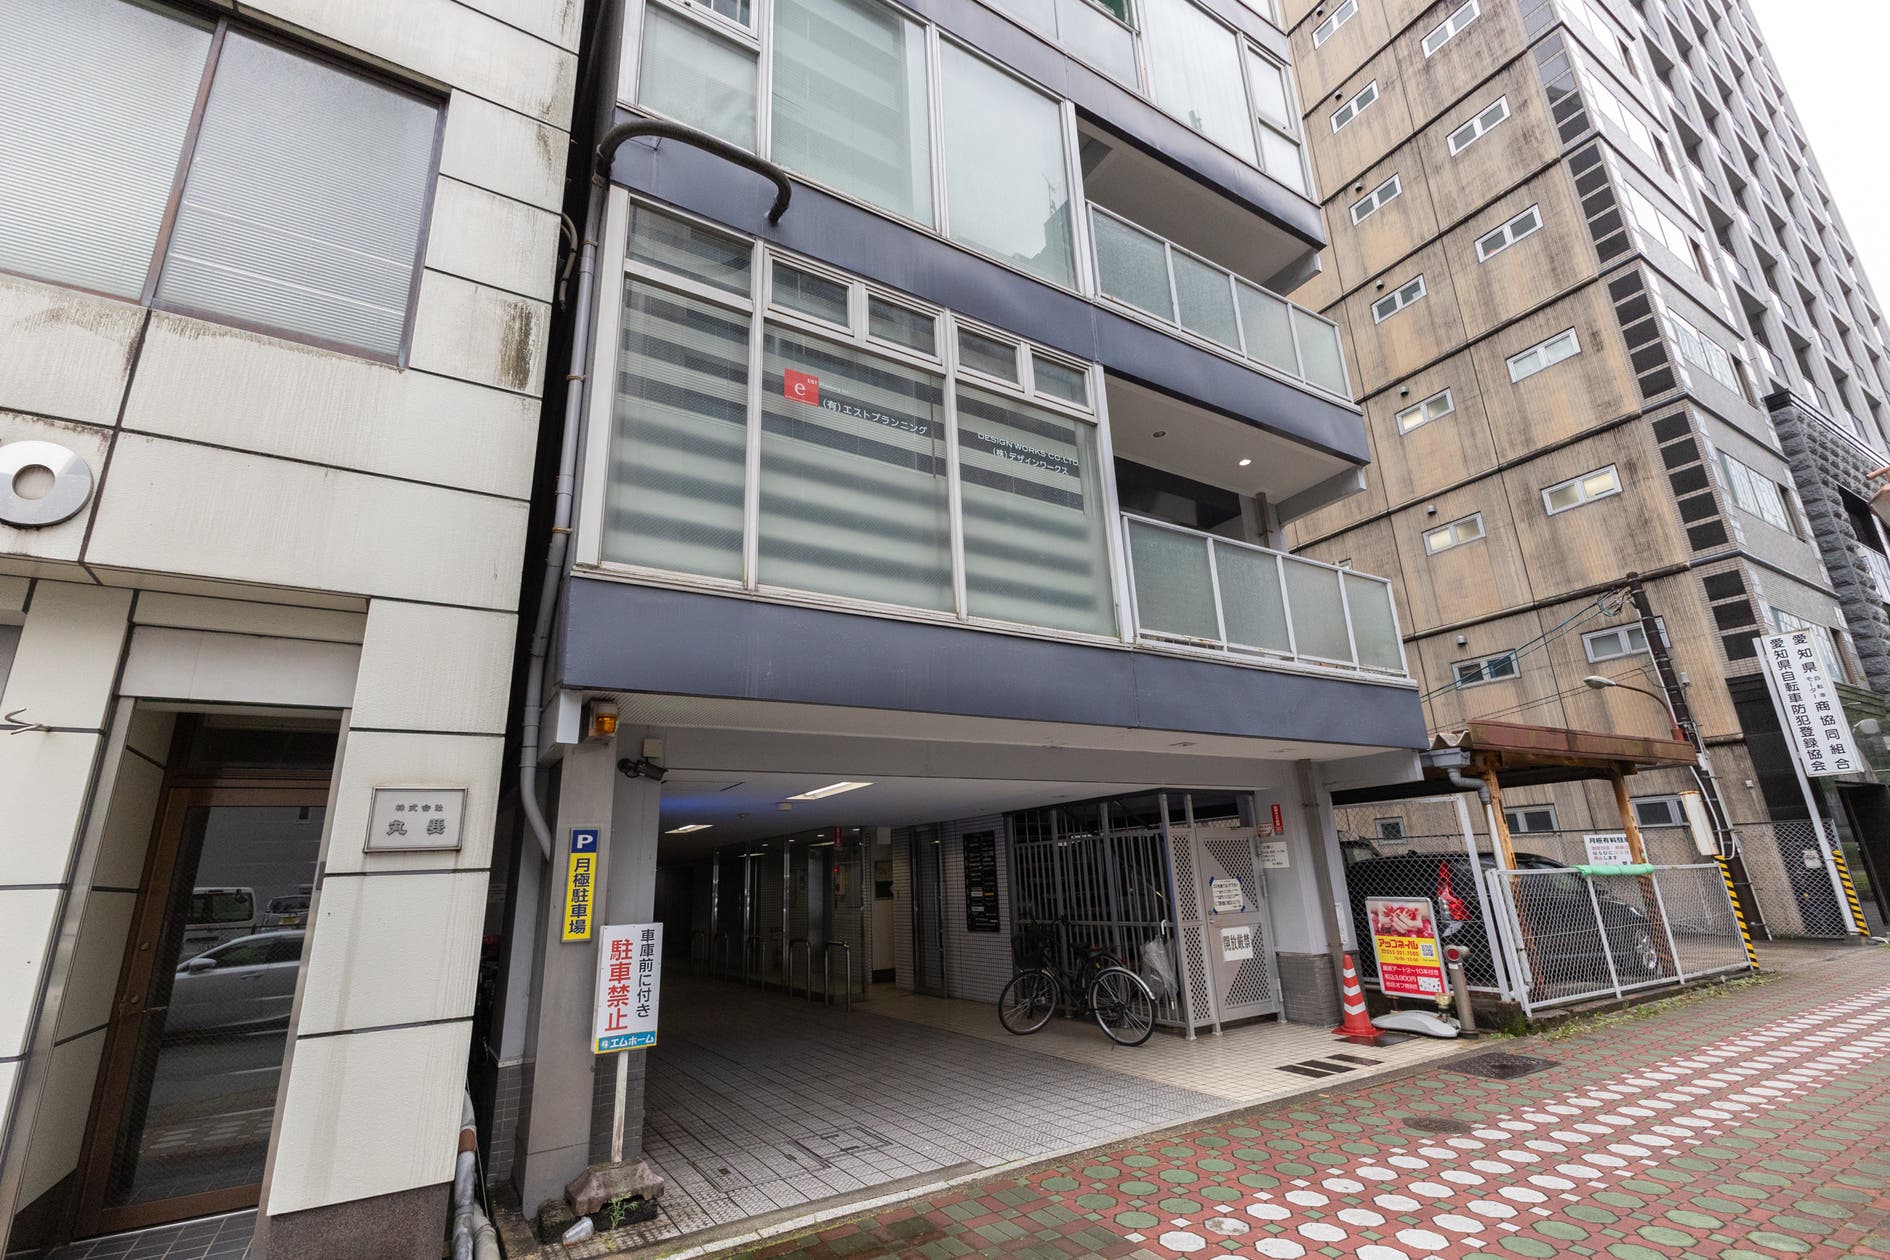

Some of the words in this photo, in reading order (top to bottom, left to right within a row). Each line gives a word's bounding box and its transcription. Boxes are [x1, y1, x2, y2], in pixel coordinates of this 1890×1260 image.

[794, 382, 806, 396] e
[822, 398, 928, 435] (有)エストプランニング
[978, 432, 1013, 448] DESIGN
[1014, 442, 1046, 457] WORKS
[992, 448, 1068, 476] (株)デザインワークス
[1770, 638, 1827, 772] 愛知県自転車防犯登録協会
[395, 804, 444, 812] 株式会社
[576, 834, 593, 848] P
[568, 858, 591, 934] 月極駐車場
[604, 938, 633, 1032] 駐車禁止
[636, 928, 655, 1018] 車庫前に付き
